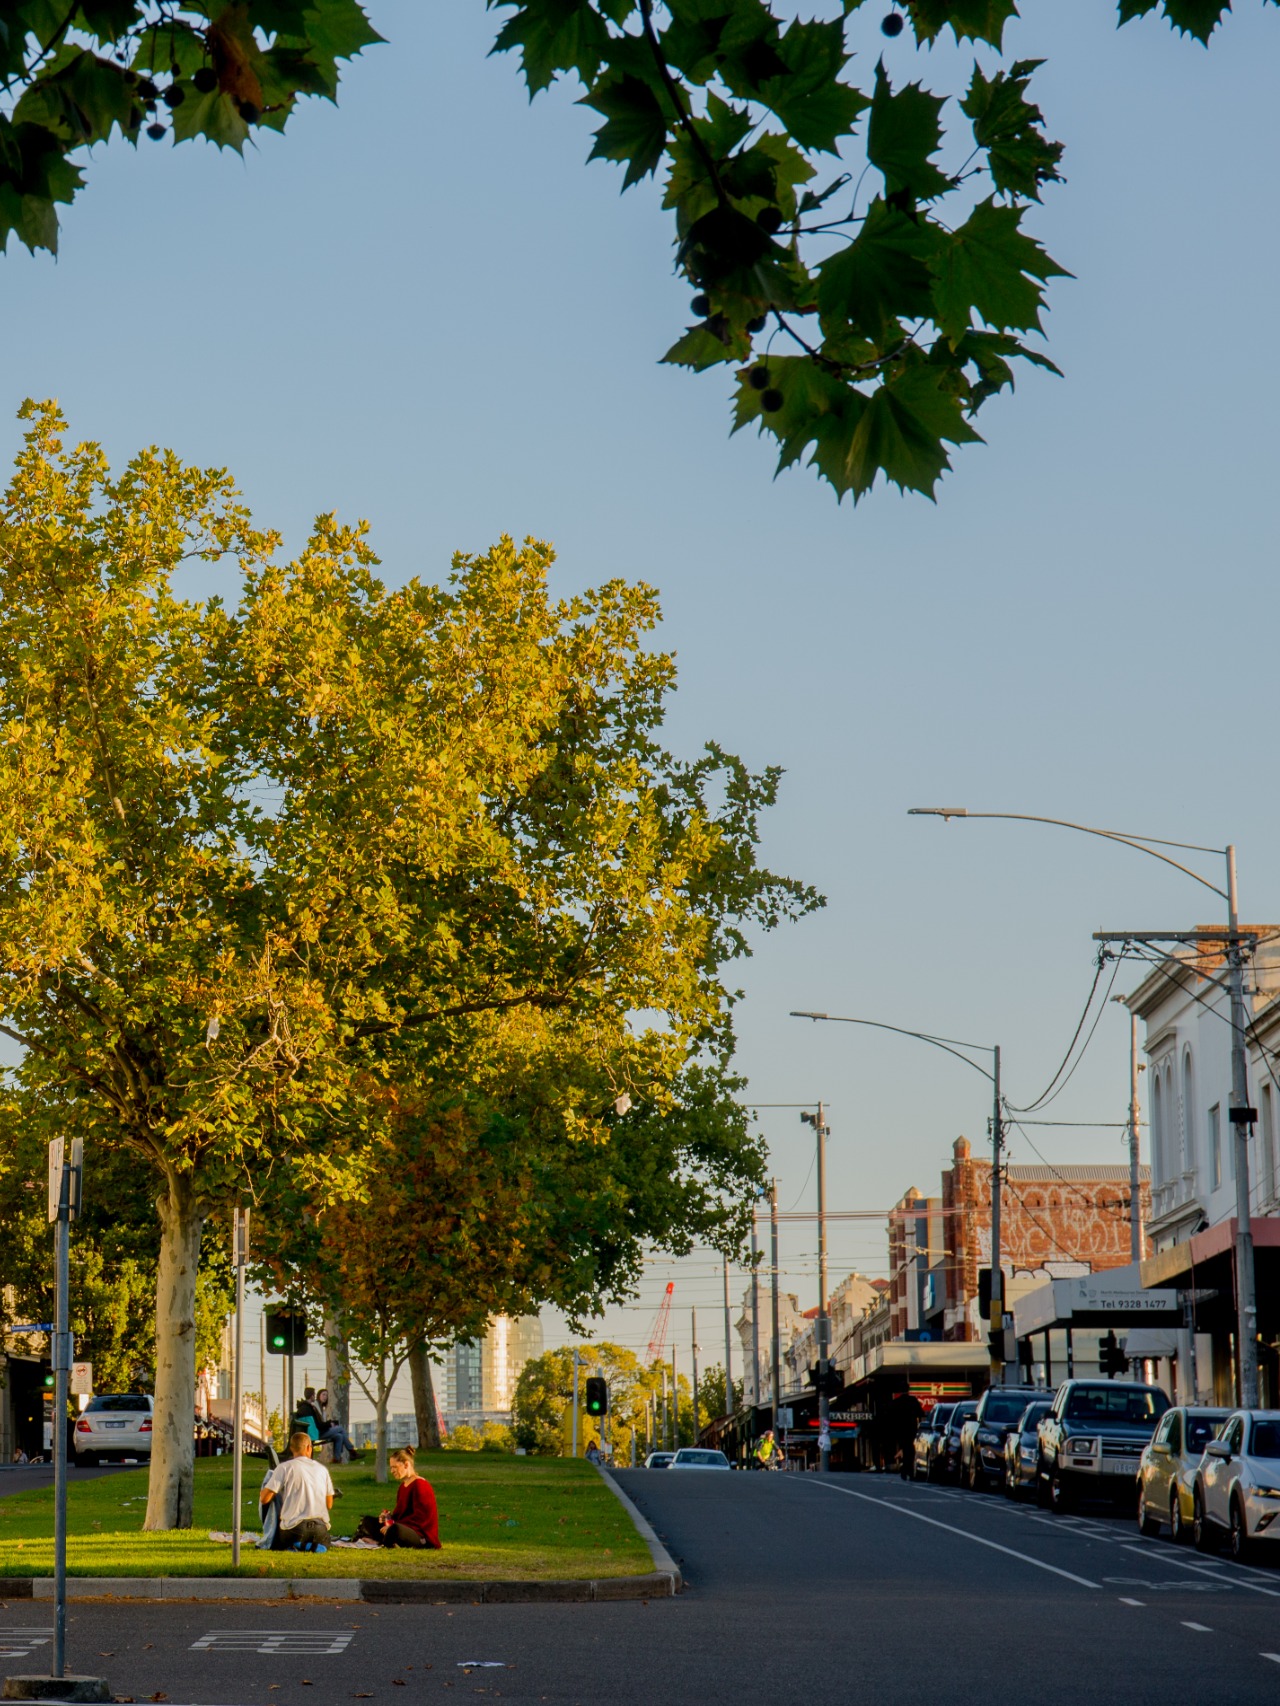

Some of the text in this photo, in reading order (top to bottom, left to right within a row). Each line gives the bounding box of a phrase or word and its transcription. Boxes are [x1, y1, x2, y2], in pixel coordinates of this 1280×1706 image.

[1100, 1300, 1167, 1309] Tel 9328 1477
[828, 1412, 873, 1420] BARBER
